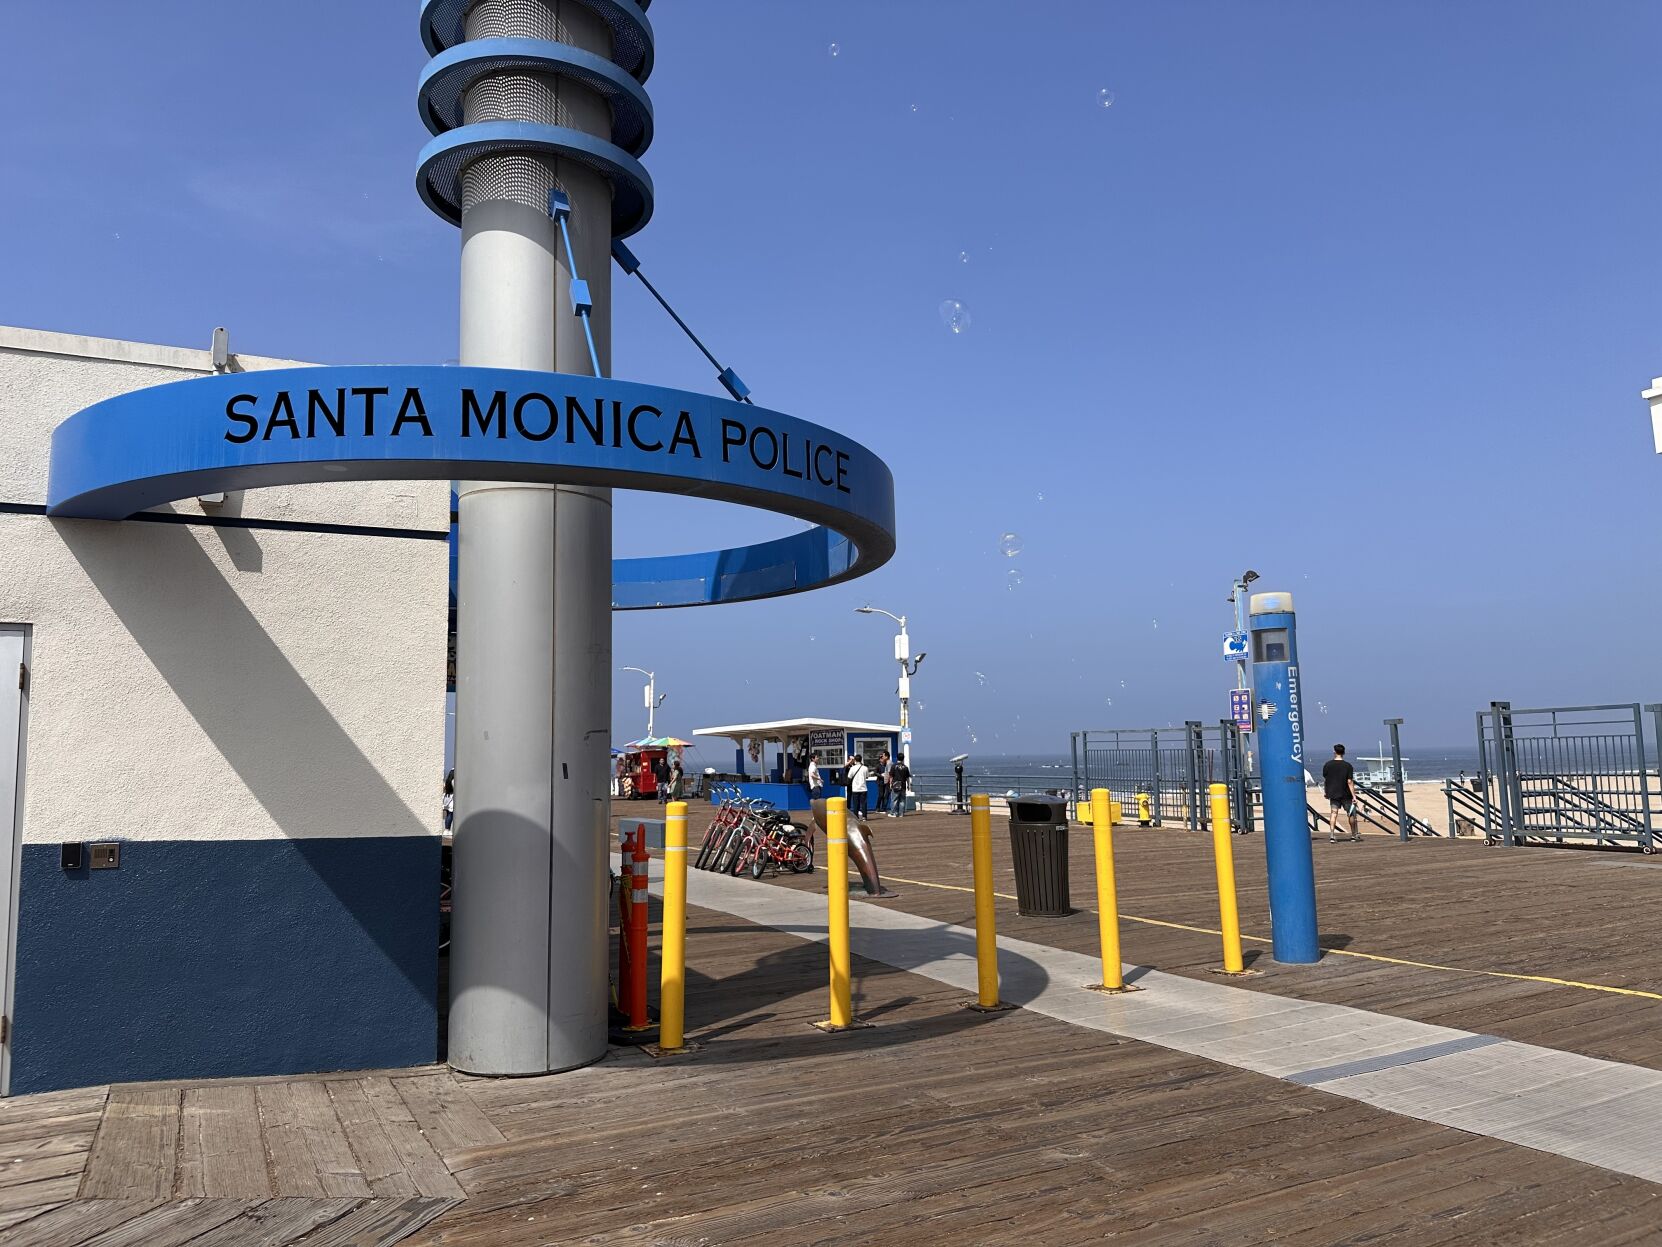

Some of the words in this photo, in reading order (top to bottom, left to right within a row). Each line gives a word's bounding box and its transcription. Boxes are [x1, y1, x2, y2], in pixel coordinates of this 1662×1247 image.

[225, 388, 433, 444] SANTA
[461, 388, 702, 459] MONICA
[722, 418, 851, 495] POLICE
[1287, 666, 1302, 763] Emergency
